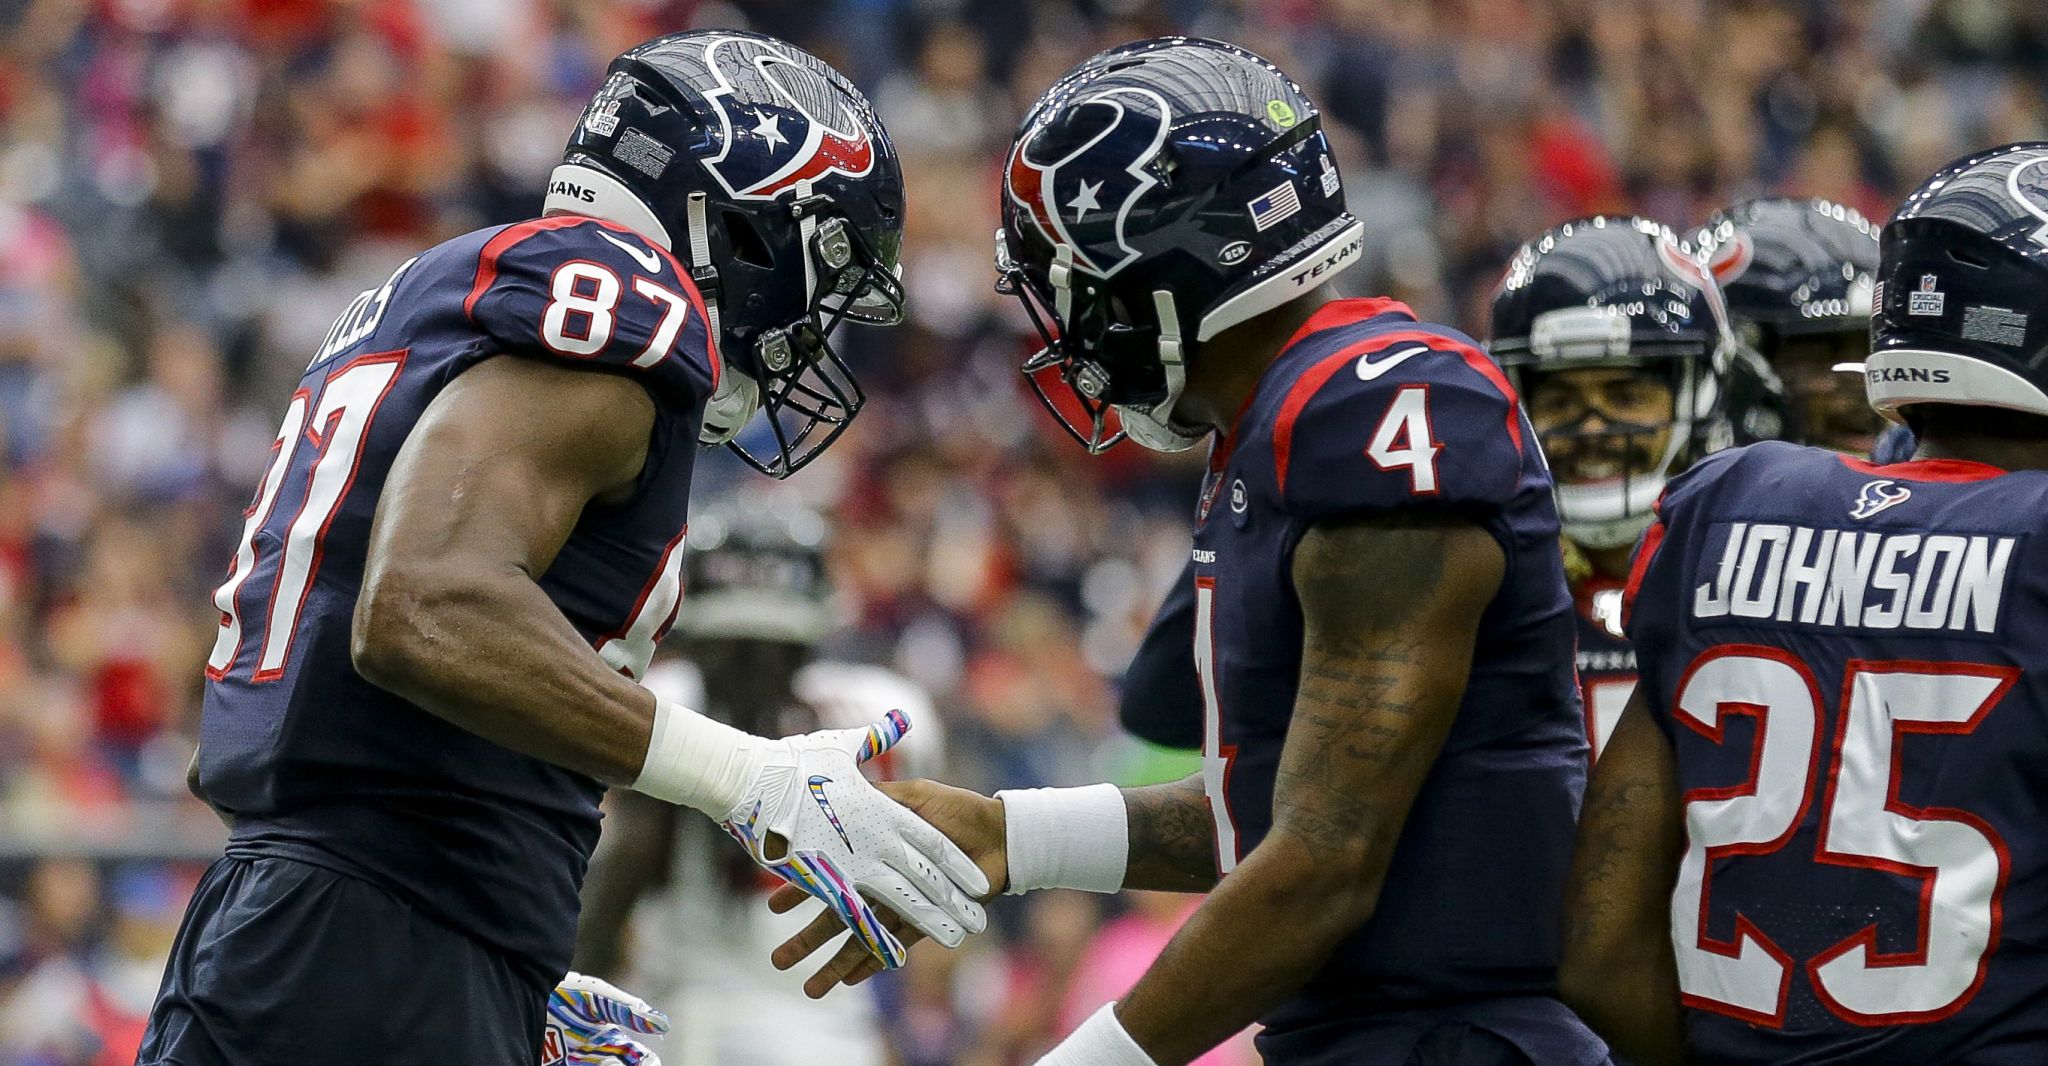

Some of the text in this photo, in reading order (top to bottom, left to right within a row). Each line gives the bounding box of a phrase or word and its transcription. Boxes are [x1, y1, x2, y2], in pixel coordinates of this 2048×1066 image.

[549, 180, 597, 203] XANS
[540, 258, 692, 369] 87
[1911, 301, 1943, 312] CATCH
[1866, 367, 1951, 384] TEXANS
[1366, 384, 1445, 494] 4
[1692, 520, 2016, 634] JOHNSON
[1669, 642, 2024, 1029] 25
